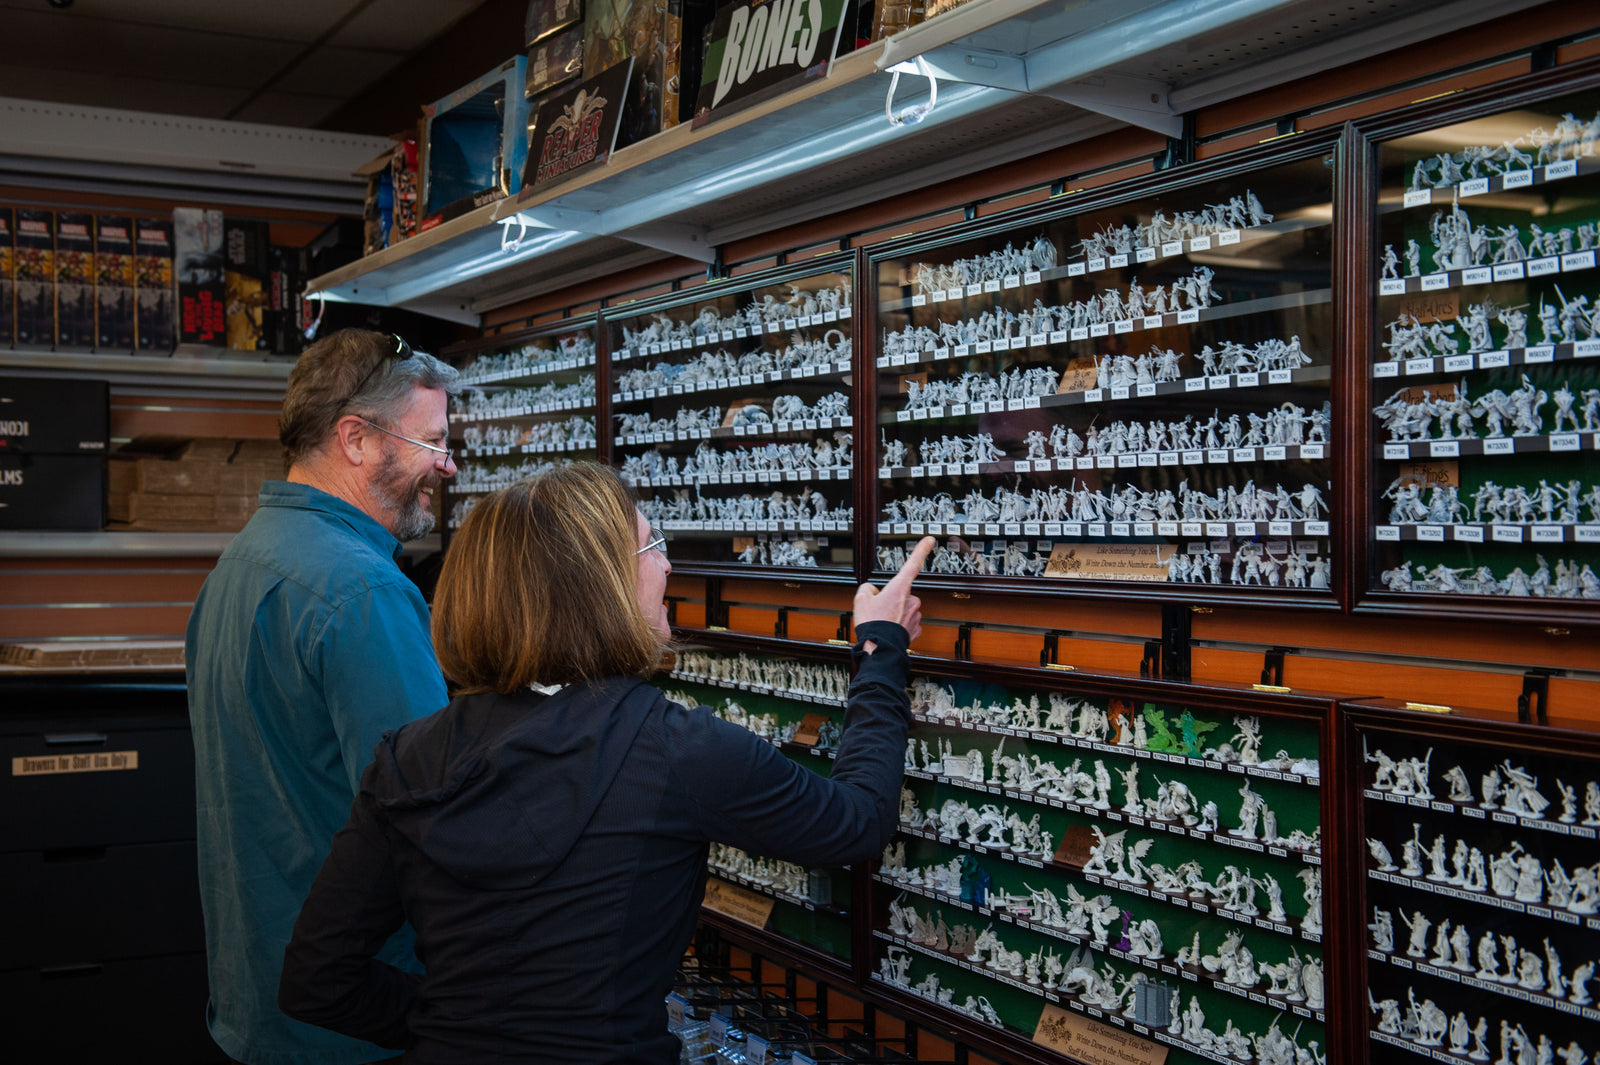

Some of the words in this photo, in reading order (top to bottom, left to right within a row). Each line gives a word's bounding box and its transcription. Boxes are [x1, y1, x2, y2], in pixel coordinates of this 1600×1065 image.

[711, 0, 822, 110] BONES
[538, 110, 603, 168] REAPER
[536, 143, 598, 184] MINIATURES
[183, 296, 195, 332] NIGHT
[198, 290, 214, 340] LIVING
[212, 300, 224, 332] DEAD
[1086, 558, 1100, 566] Write
[1102, 559, 1116, 567] Down
[1128, 560, 1149, 568] Number
[1108, 546, 1136, 556] Something
[1076, 1032, 1091, 1046] Write
[1091, 1038, 1108, 1054] Down
[1108, 1044, 1118, 1056] the
[1118, 1047, 1140, 1064] Number
[1087, 1023, 1100, 1036] Like
[1099, 1027, 1127, 1045] Something
[1128, 1035, 1140, 1048] You
[1067, 1046, 1080, 1059] Staff
[1080, 1050, 1102, 1065] Member
